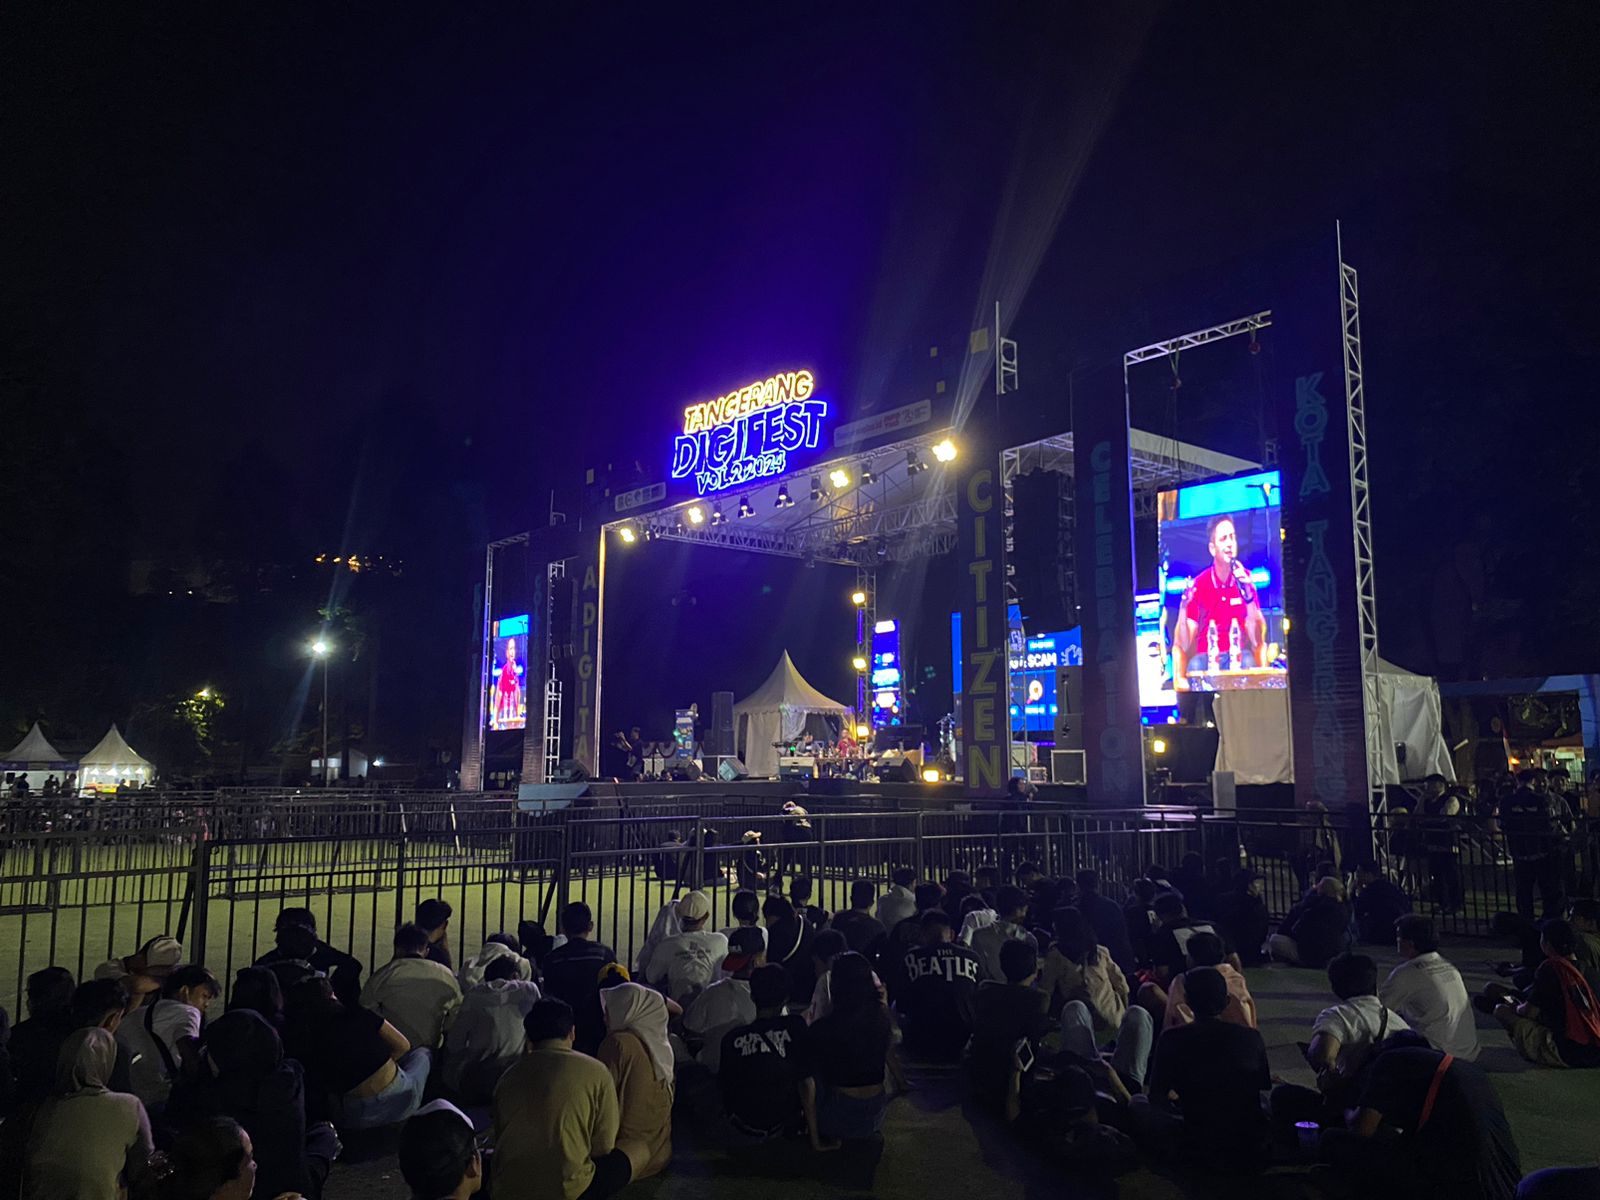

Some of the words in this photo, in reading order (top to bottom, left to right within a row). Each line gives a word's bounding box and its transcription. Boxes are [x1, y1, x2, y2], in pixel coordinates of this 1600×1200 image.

[684, 370, 814, 435] TANGERANG
[1294, 370, 1332, 497] KOTA
[672, 401, 827, 478] DIGIFEST
[967, 470, 1001, 790] CITIZEN
[1027, 652, 1057, 668] SCAM
[904, 953, 979, 983] BEATLES
